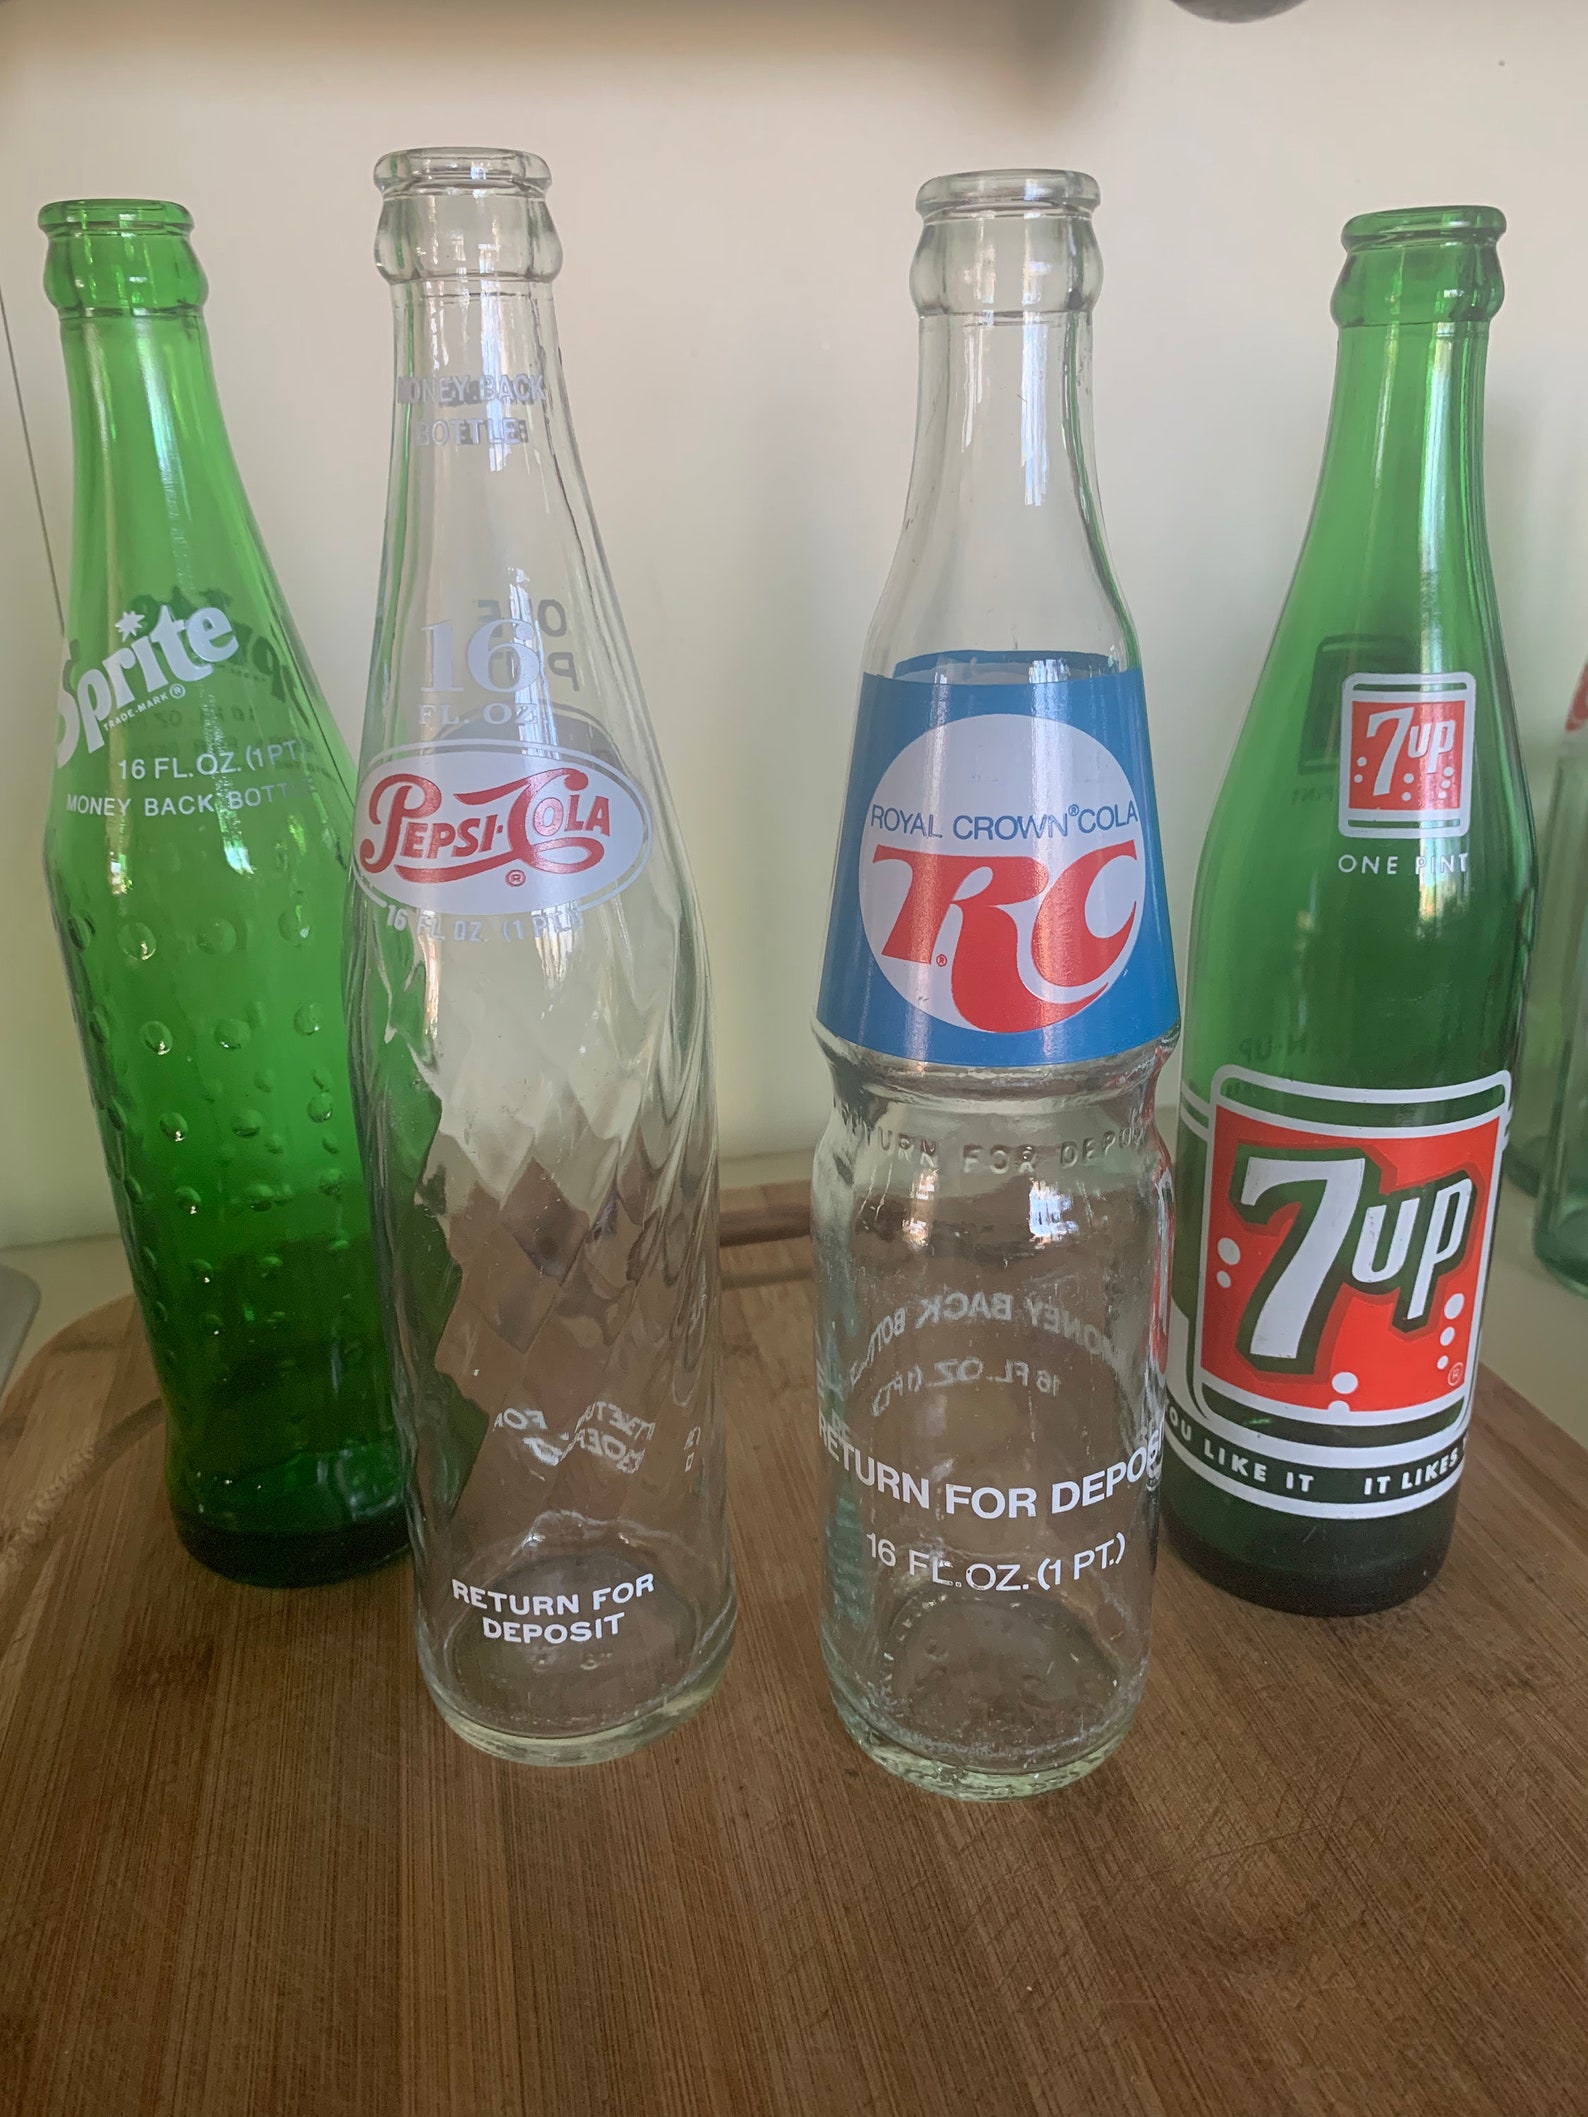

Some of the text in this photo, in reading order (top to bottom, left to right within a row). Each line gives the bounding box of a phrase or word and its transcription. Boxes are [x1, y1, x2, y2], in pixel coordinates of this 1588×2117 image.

[479, 373, 546, 402] BACK
[417, 418, 522, 446] BOTTLE
[420, 619, 540, 692] 16
[118, 759, 146, 780] 16
[66, 779, 311, 817] MONEY BACK BOTT
[871, 804, 943, 839] ROYAL
[1078, 800, 1138, 834] COLA
[1338, 852, 1468, 875] ONE PINT
[386, 904, 407, 931] 16
[873, 839, 1137, 1034] RC
[818, 1408, 1160, 1520] RETURN FOR DEPOS
[1169, 1406, 1315, 1493] OU LIKE IT
[1364, 1447, 1459, 1495] IT LIKES
[866, 1533, 896, 1567] 16
[451, 1572, 655, 1616] RETURN FOR
[482, 1612, 625, 1645] DEPOSIT
